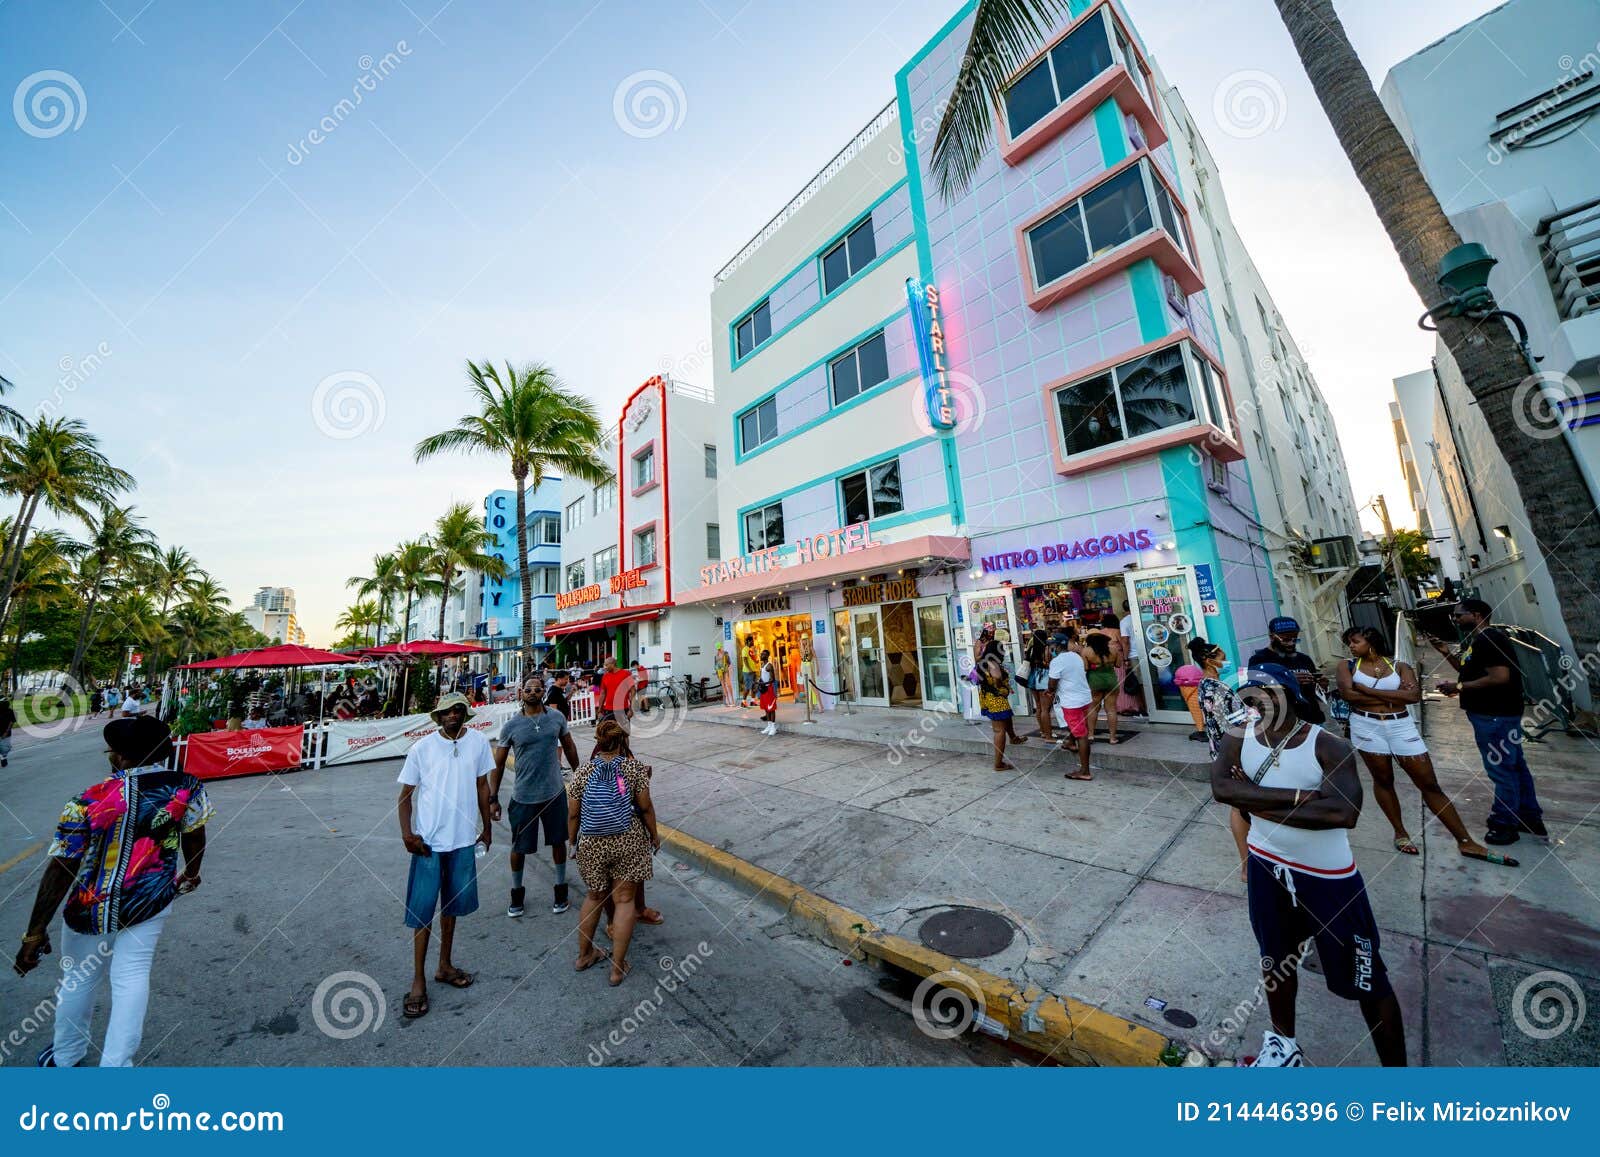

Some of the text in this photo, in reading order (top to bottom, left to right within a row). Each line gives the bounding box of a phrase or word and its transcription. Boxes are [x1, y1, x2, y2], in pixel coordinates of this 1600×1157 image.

[926, 284, 952, 424] STARLITE
[700, 521, 881, 587] STARLITE HOTEL
[981, 529, 1152, 573] NITRO DRAGONS
[556, 569, 647, 610] BOULEVARD HOTEL
[842, 578, 919, 607] STARLITE HOTEL
[226, 745, 272, 755] BOULEVARD
